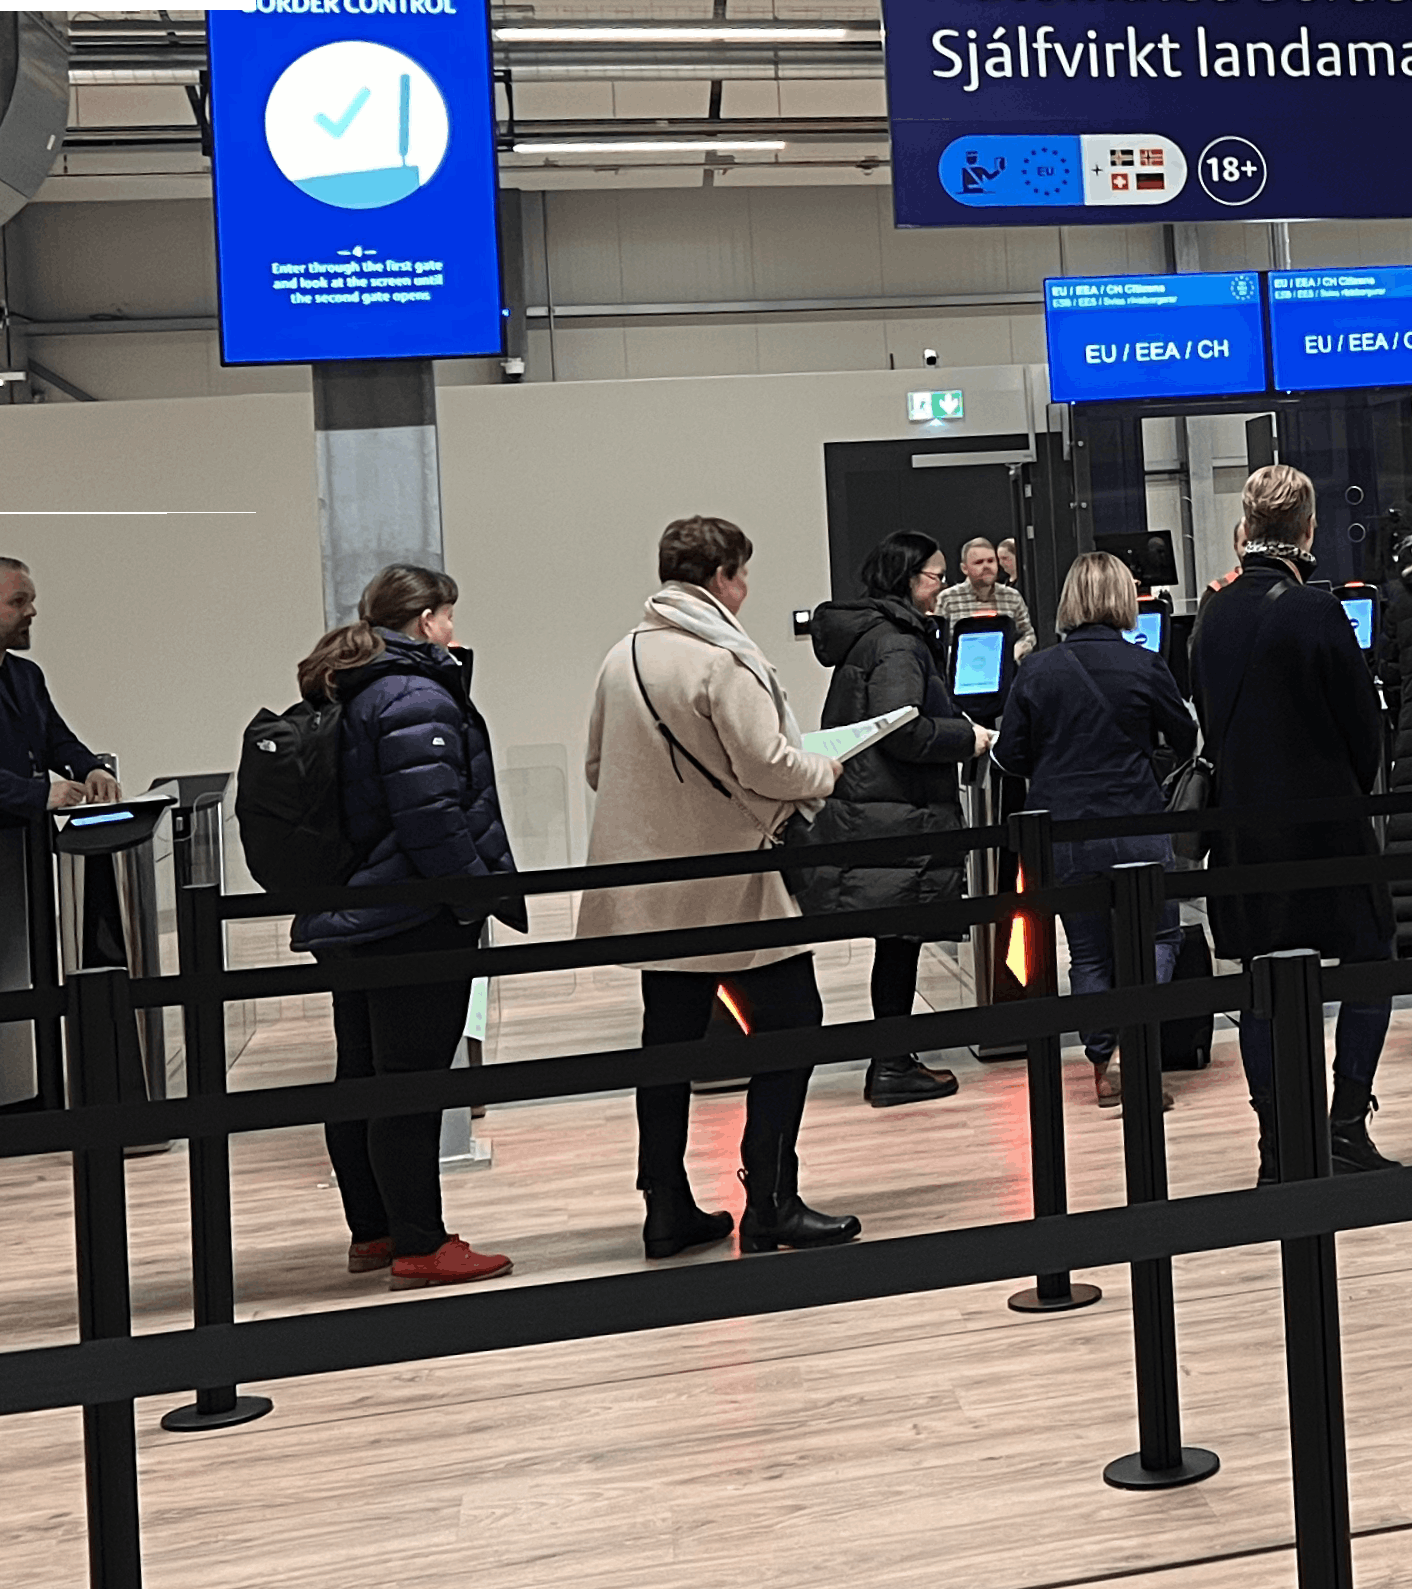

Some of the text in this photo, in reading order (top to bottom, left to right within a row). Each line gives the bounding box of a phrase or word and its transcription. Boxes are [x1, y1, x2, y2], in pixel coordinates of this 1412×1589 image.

[242, 0, 340, 14] ORDER
[931, 25, 1182, 92] Sjálfvirkt
[1036, 166, 1054, 176] EU
[1206, 156, 1258, 182] 18+
[272, 259, 443, 275] Enter through the first gate
[272, 274, 443, 289] and look at the screen until
[290, 290, 431, 305] the second gate opens
[1304, 335, 1332, 354] EU
[1337, 334, 1344, 352] /
[1349, 333, 1388, 352] EEA
[1393, 332, 1399, 350] /
[1086, 339, 1230, 364] EU / EEA / CH
